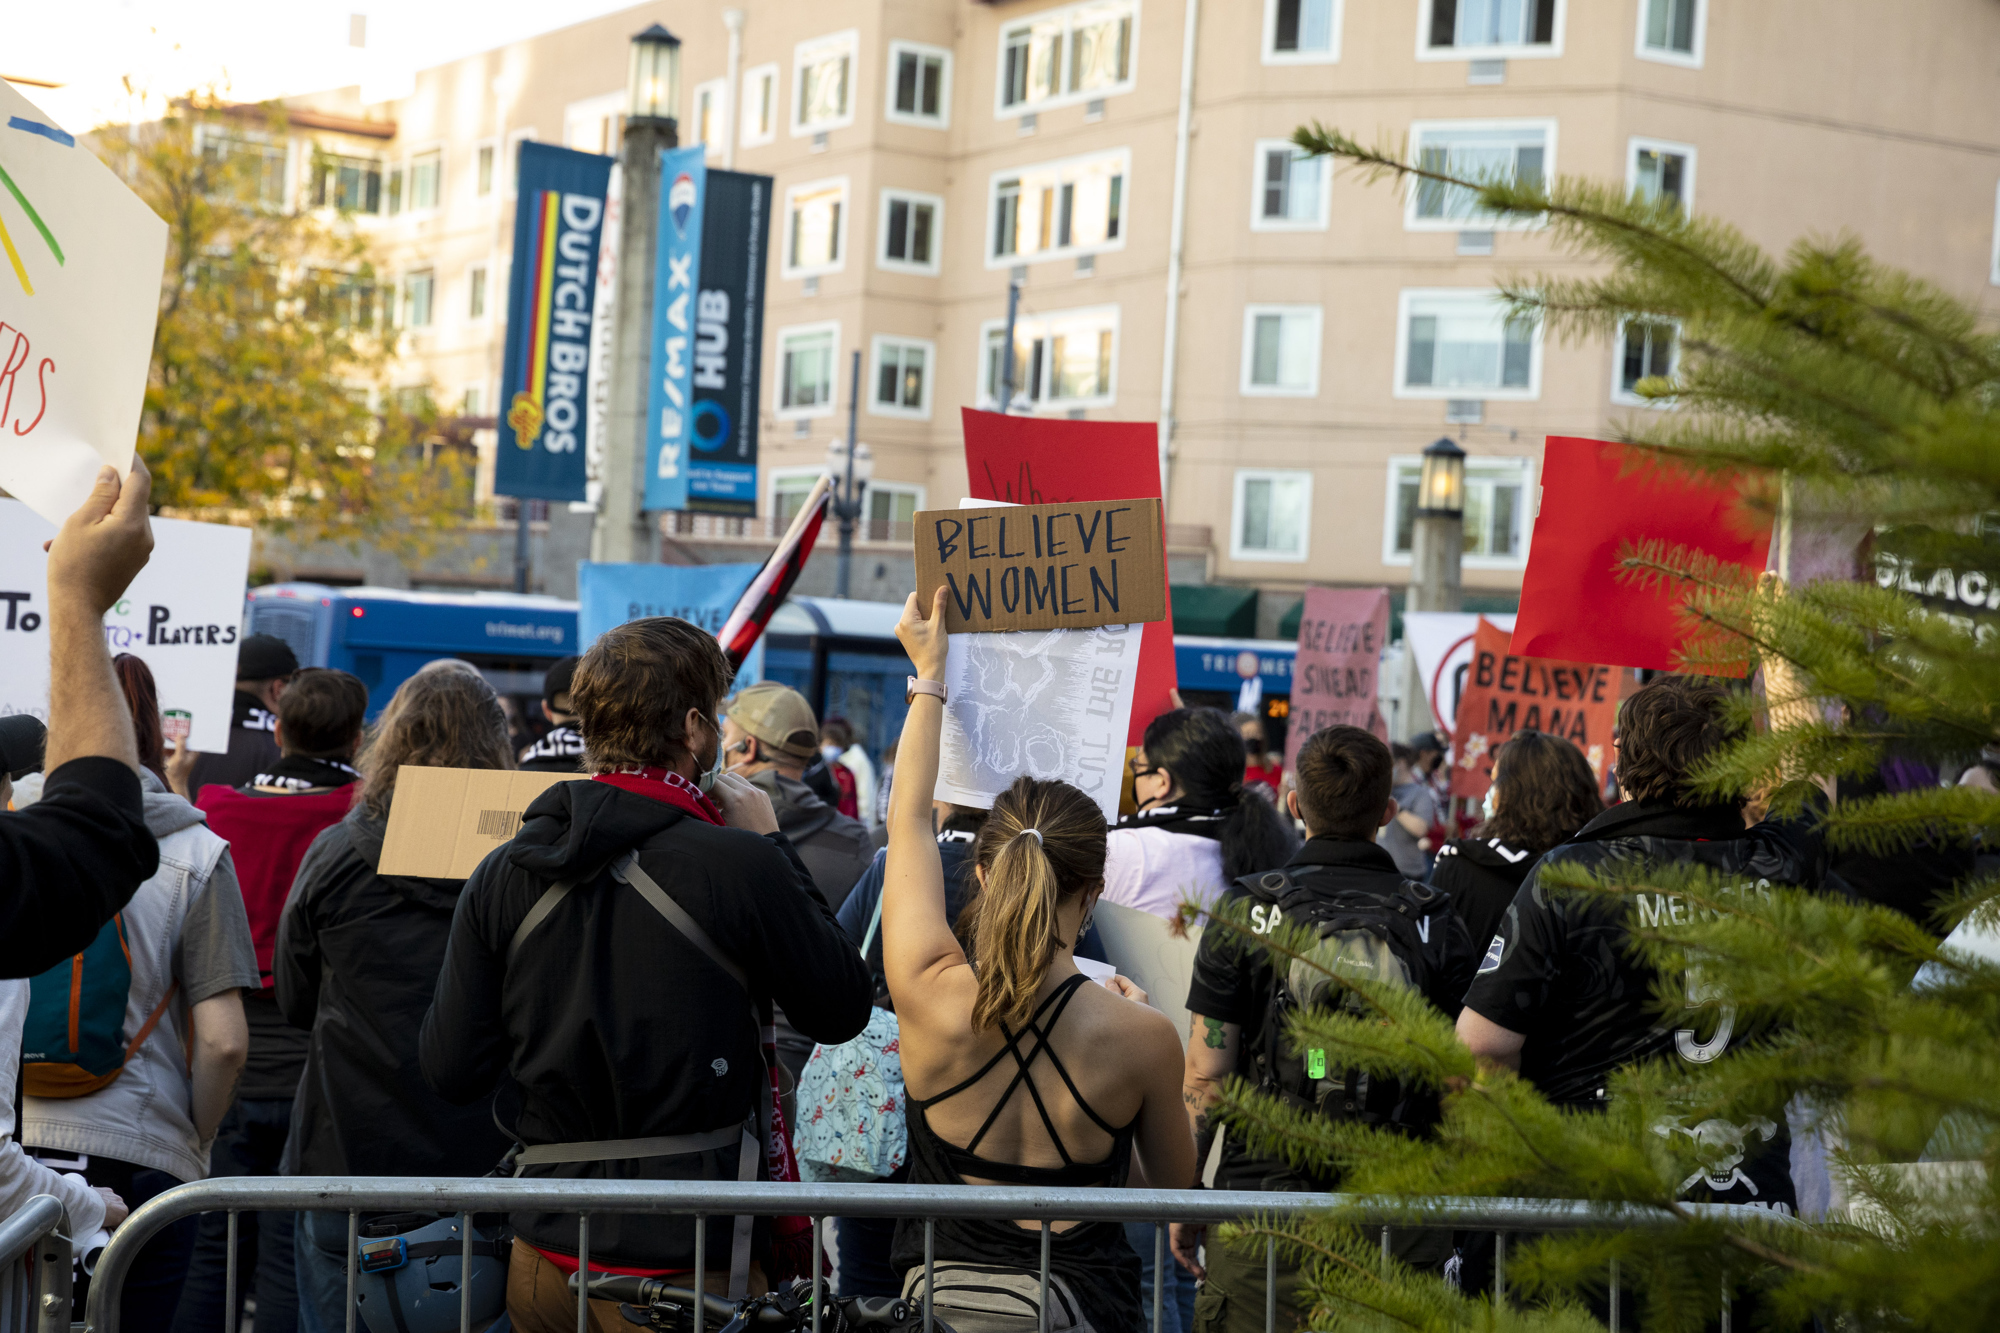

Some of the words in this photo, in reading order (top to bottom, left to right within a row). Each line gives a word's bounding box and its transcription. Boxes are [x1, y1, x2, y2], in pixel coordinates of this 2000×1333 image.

[553, 192, 602, 338] DUTCH
[657, 252, 692, 479] RE/MAX
[692, 288, 731, 390] HUB
[0, 322, 56, 436] RS
[544, 342, 588, 453] BROS
[935, 507, 1132, 564] BELIEVE
[946, 558, 1120, 621] WOMEN
[147, 605, 237, 645] PLAYERS
[485, 620, 565, 645] trimet.org
[1201, 652, 1237, 673] TRI
[1475, 651, 1610, 704] BELIEVE
[1487, 697, 1588, 745] MANA
[1675, 944, 1739, 1064] 5
